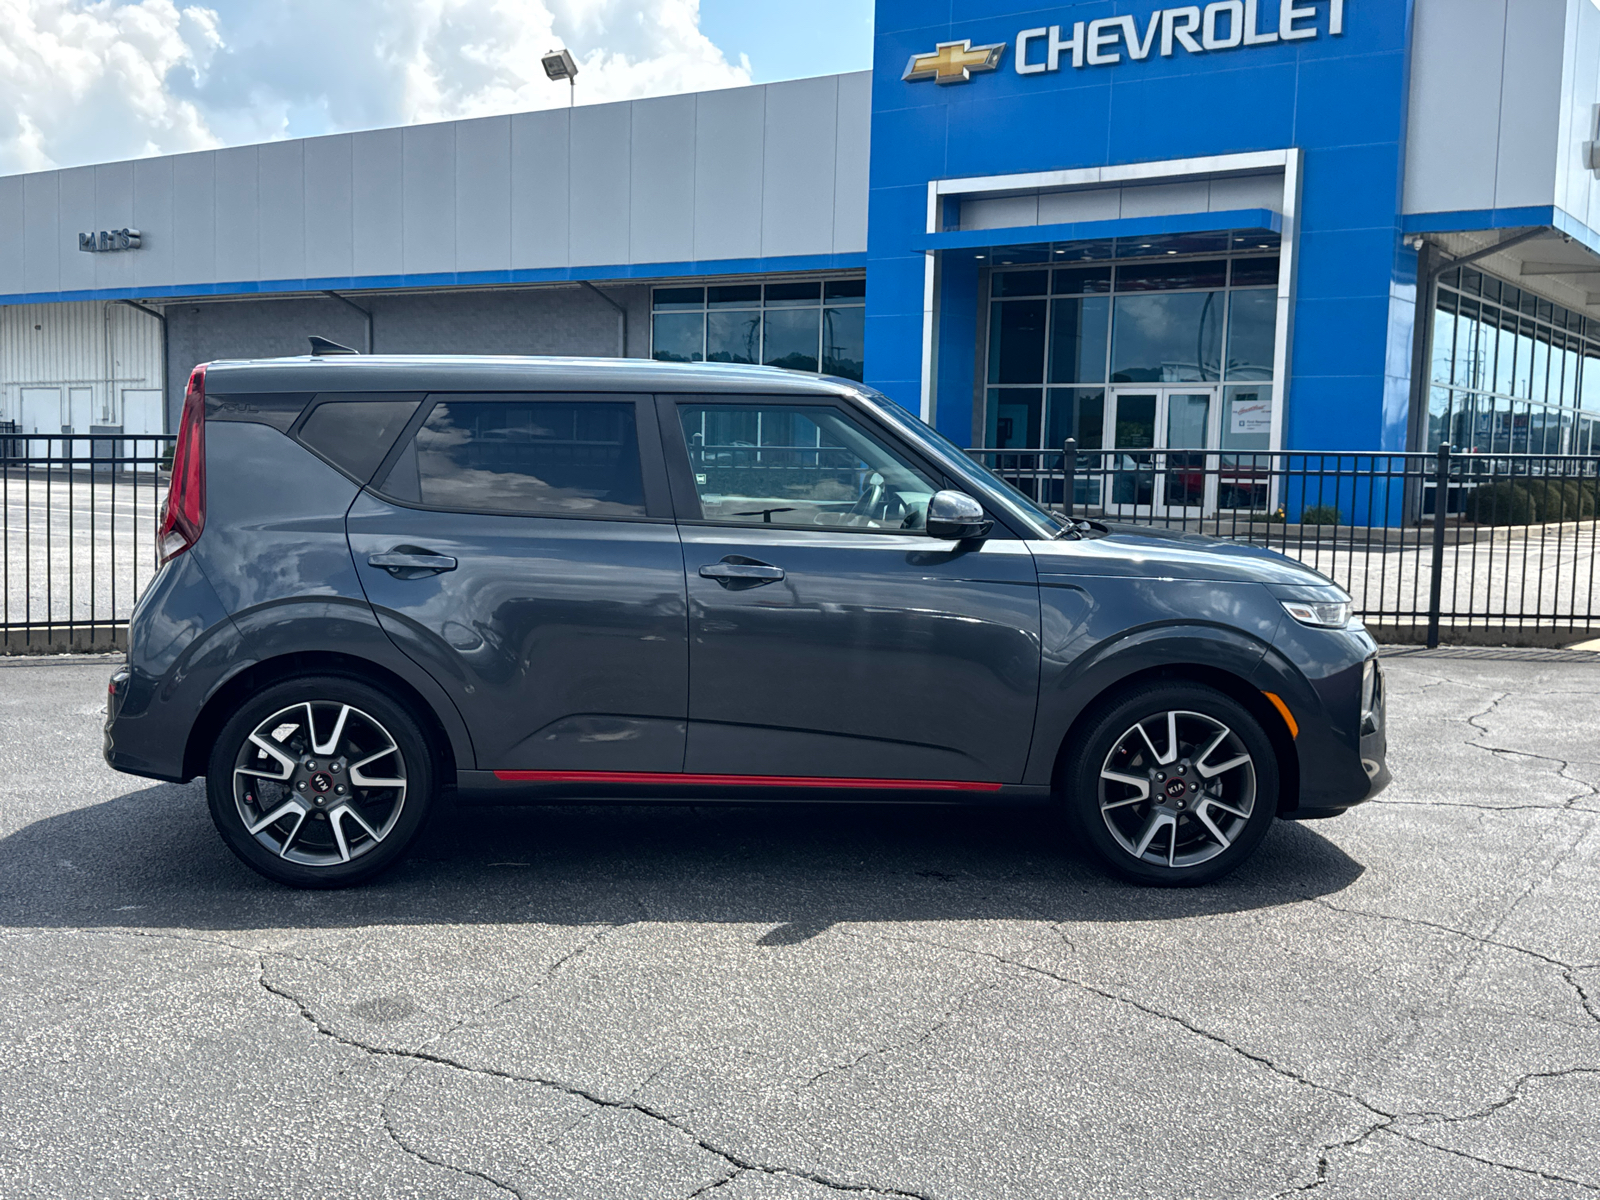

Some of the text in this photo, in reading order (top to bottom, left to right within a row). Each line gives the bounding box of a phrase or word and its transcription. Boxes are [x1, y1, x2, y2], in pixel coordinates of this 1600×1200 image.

[79, 228, 134, 252] PARTS
[213, 402, 260, 413] SOUL
[315, 774, 329, 791] KIA
[1167, 783, 1185, 795] KIA
